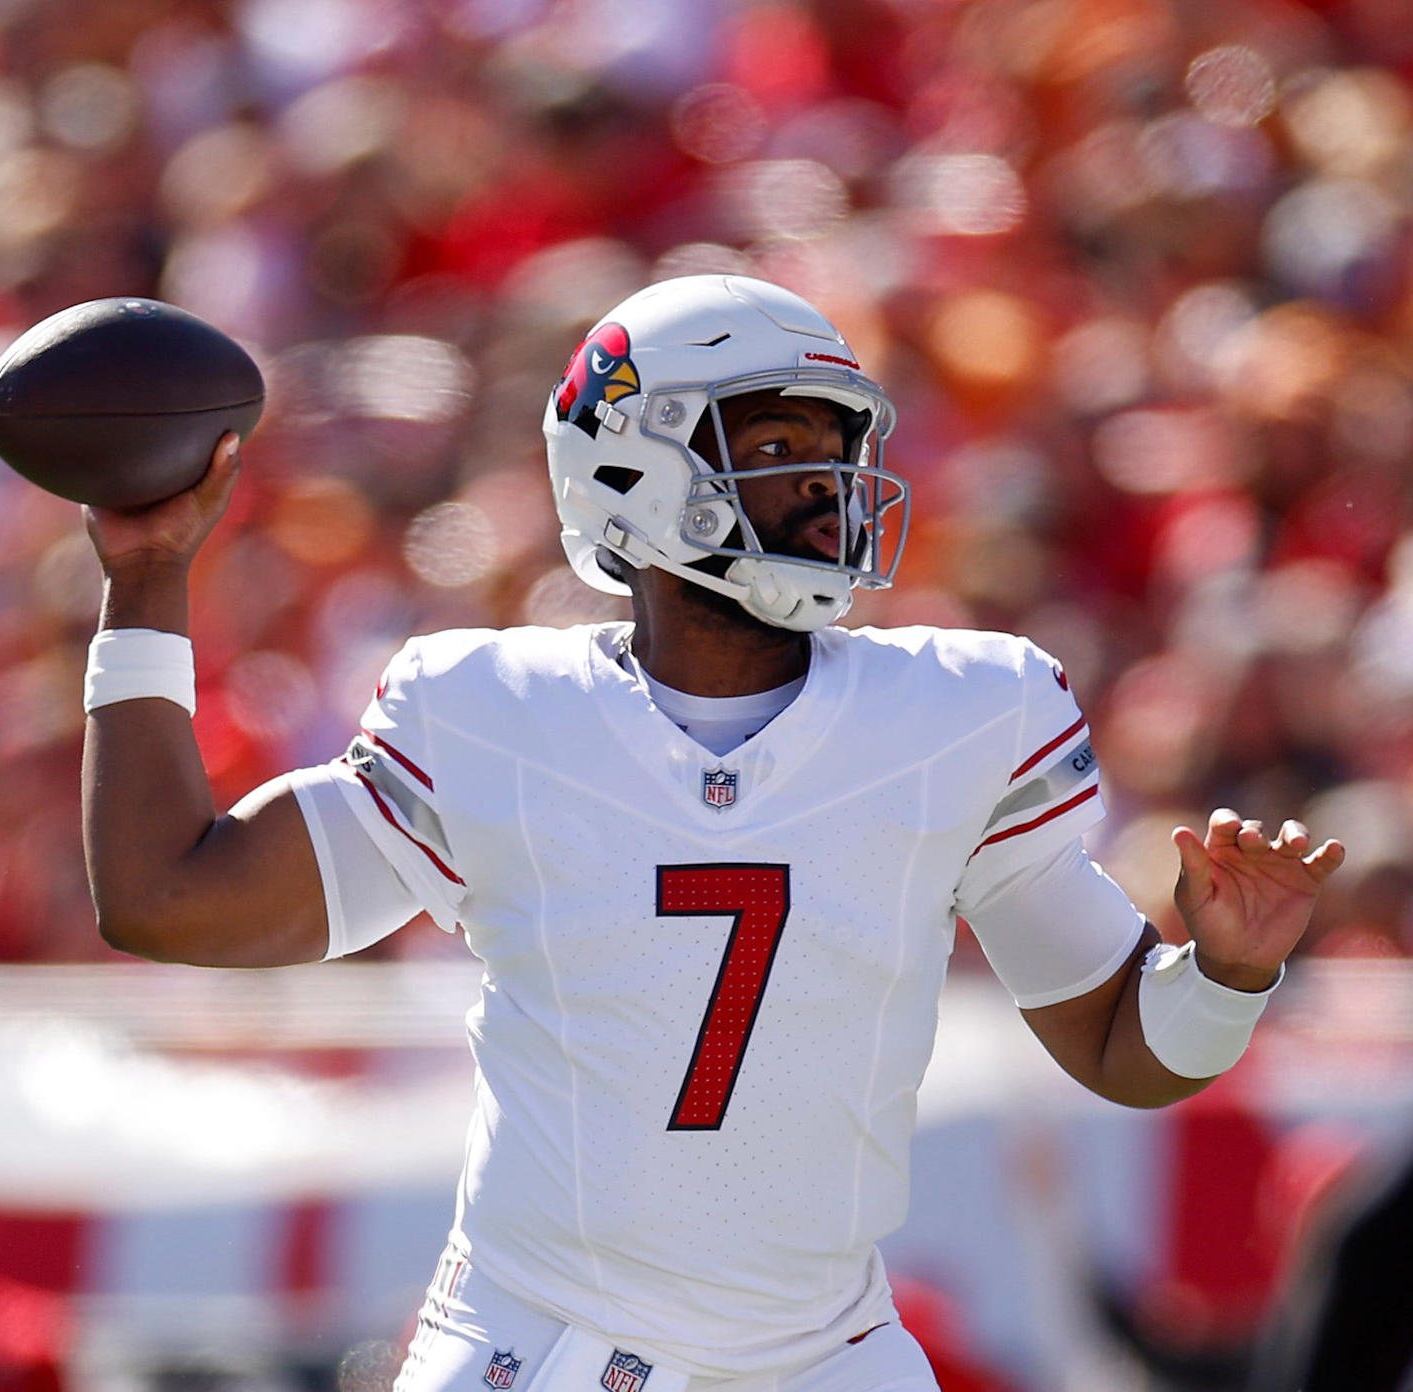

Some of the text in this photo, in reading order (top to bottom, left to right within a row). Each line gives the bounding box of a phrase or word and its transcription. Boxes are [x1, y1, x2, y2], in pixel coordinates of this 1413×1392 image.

[706, 785, 734, 804] NFL
[655, 862, 791, 1132] 7
[487, 1364, 512, 1386] NFL
